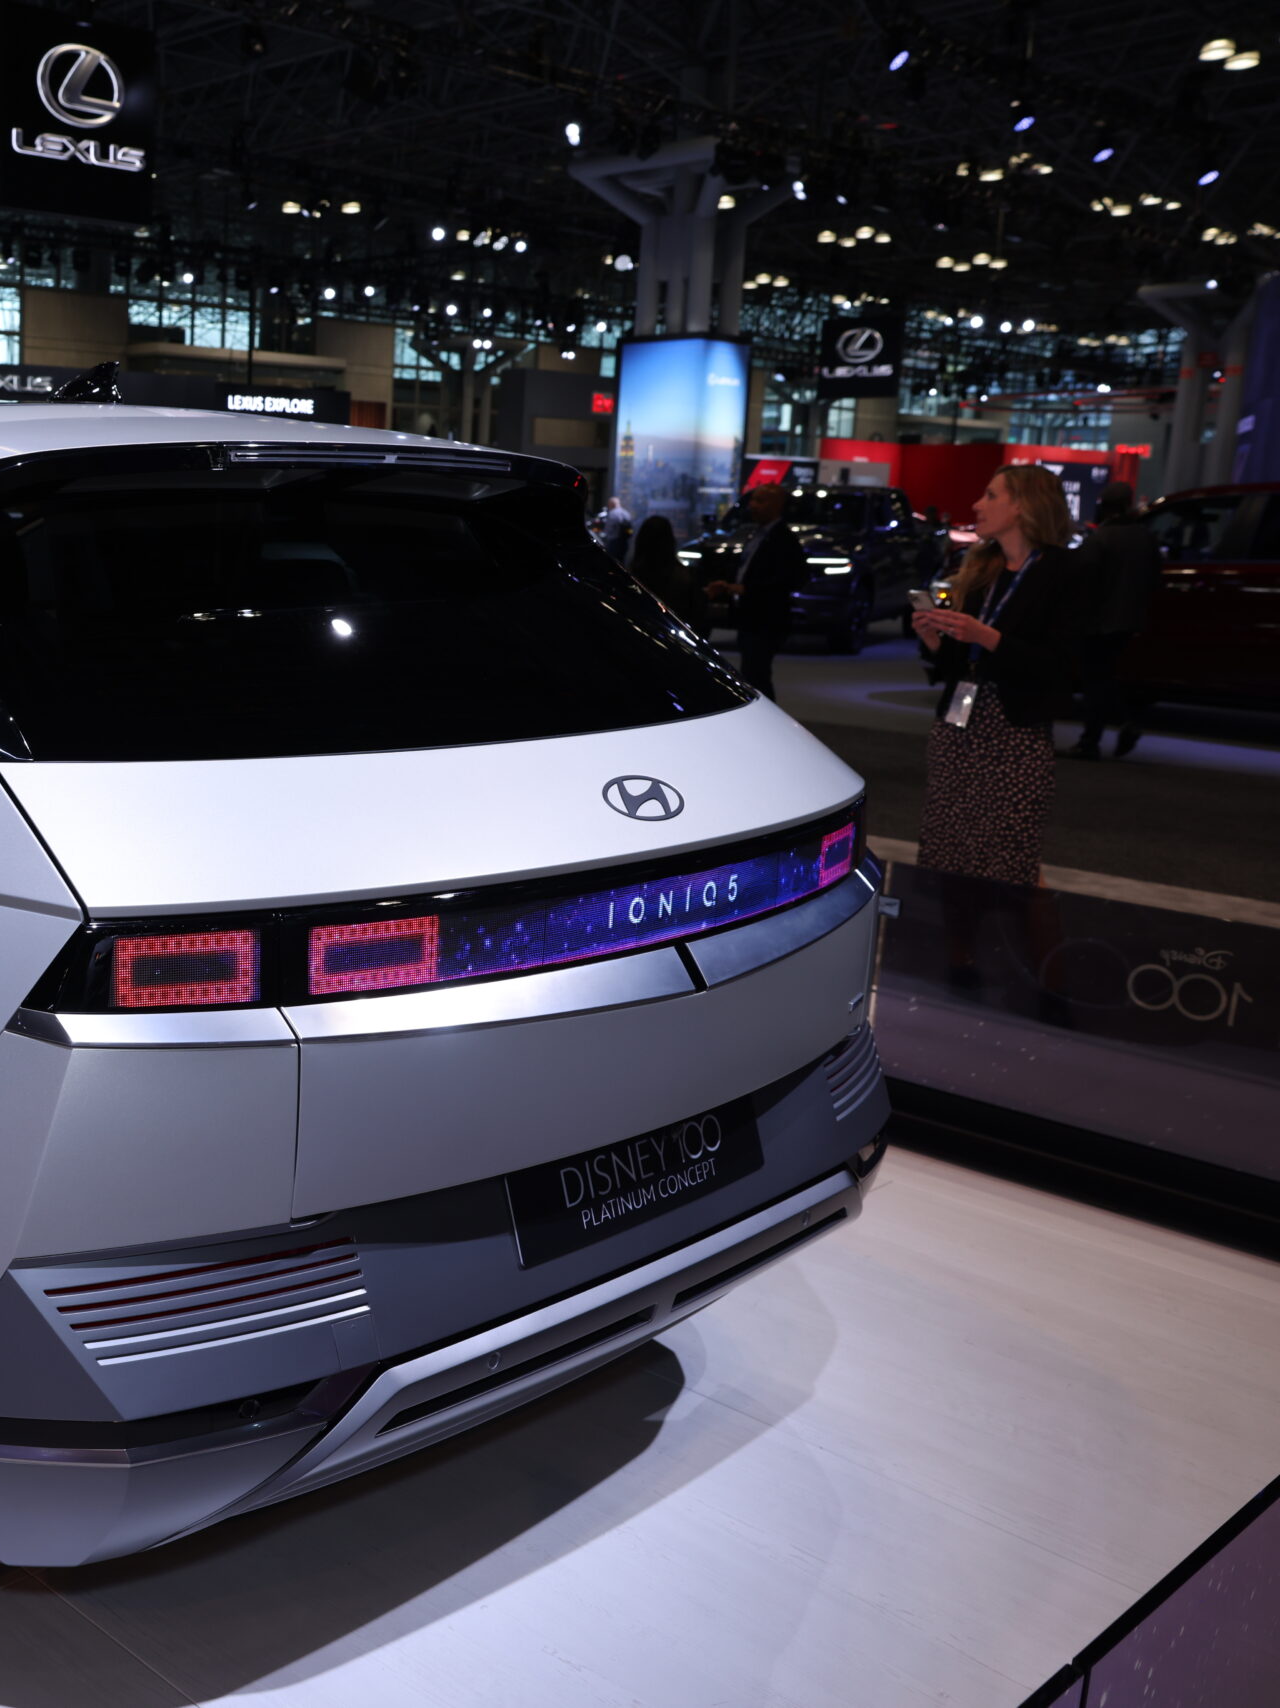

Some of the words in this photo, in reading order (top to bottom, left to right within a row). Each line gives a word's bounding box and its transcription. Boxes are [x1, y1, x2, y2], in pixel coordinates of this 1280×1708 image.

[11, 127, 147, 172] LEXUS
[227, 394, 264, 412] LEXUS
[264, 396, 314, 415] EXPLORE
[559, 1135, 667, 1209] DISNEY
[671, 1114, 721, 1163] 100
[581, 1184, 656, 1229] PLATINUM
[658, 1158, 717, 1198] CONCEPT
